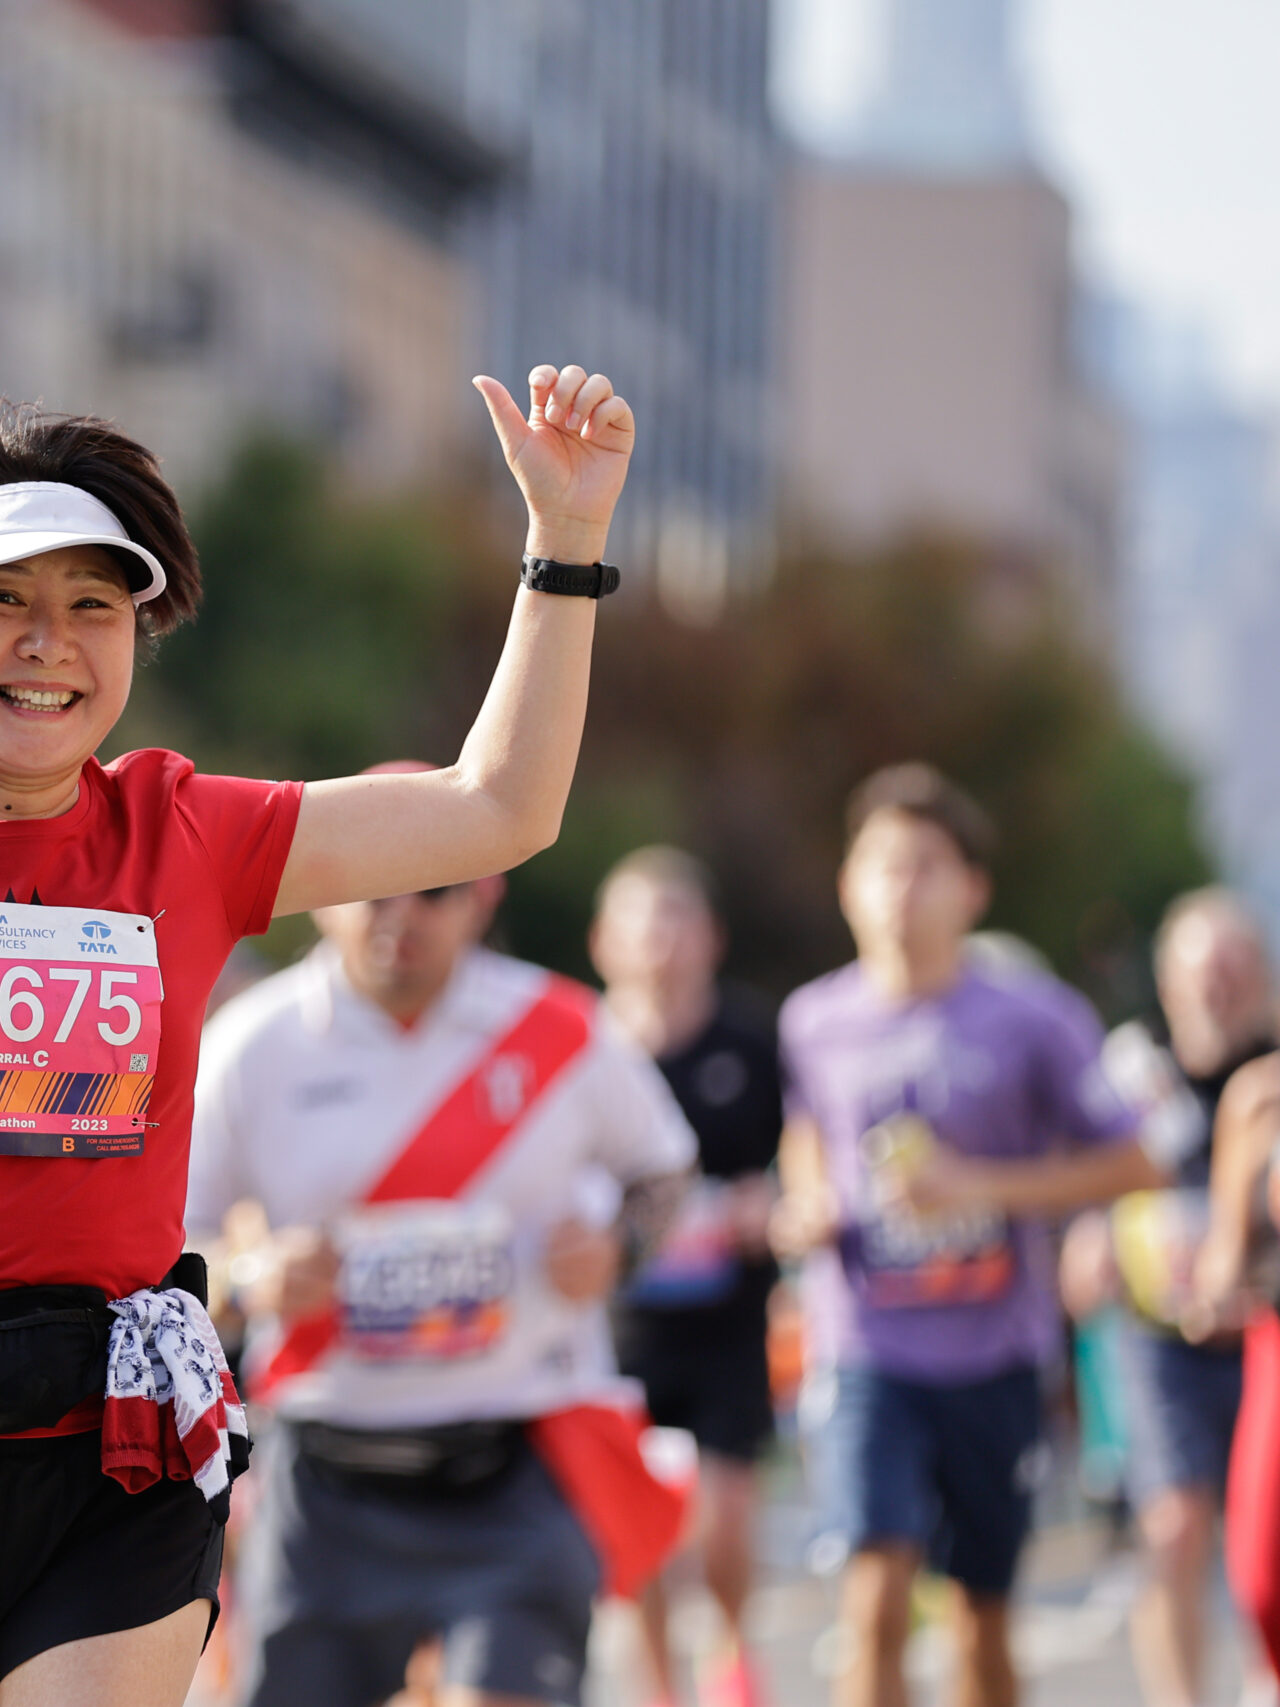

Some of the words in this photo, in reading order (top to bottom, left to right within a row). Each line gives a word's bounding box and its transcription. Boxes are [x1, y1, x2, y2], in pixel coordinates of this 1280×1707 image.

[77, 941, 118, 955] TATA
[32, 1050, 49, 1068] C
[71, 1118, 108, 1131] 2023
[62, 1137, 75, 1152] B
